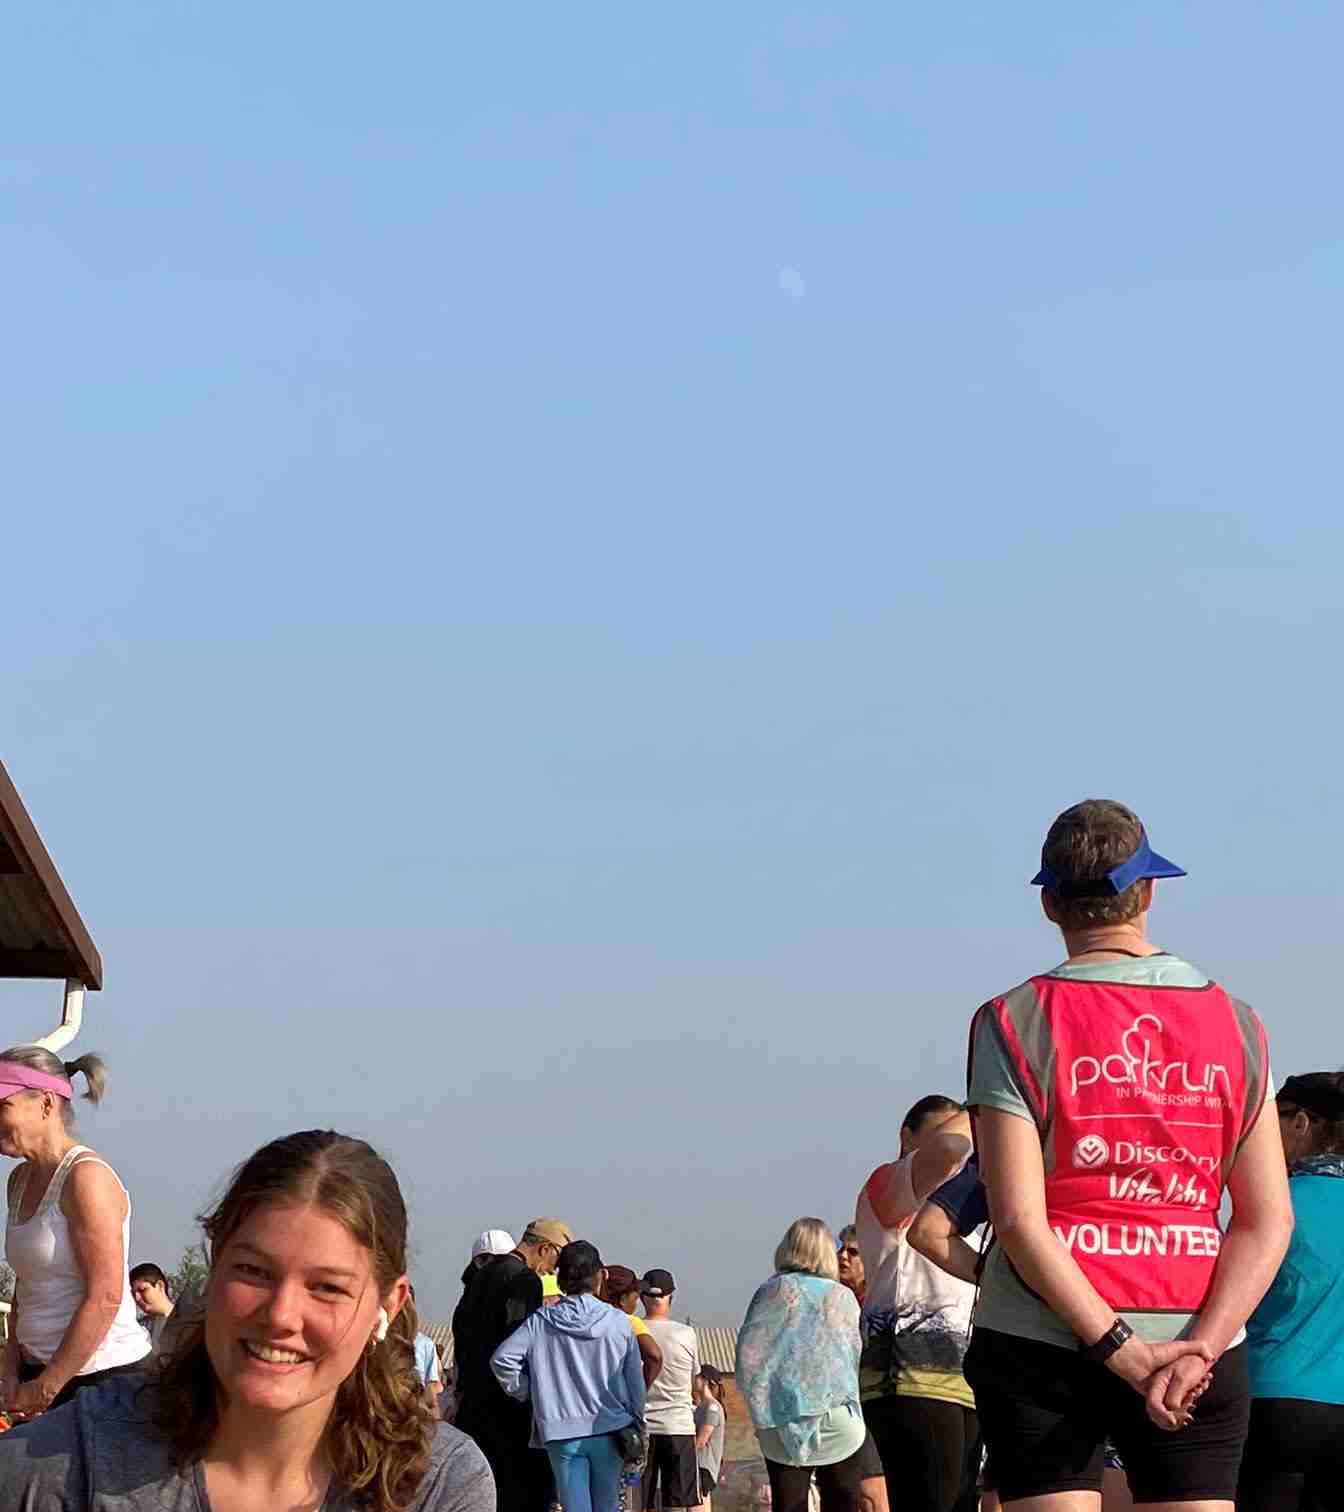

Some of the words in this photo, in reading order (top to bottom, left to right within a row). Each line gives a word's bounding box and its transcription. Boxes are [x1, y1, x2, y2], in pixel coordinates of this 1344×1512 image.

[1071, 1036, 1233, 1108] parkrun
[1116, 1087, 1130, 1097] IN
[1053, 1224, 1220, 1256] VOLUNTEE
